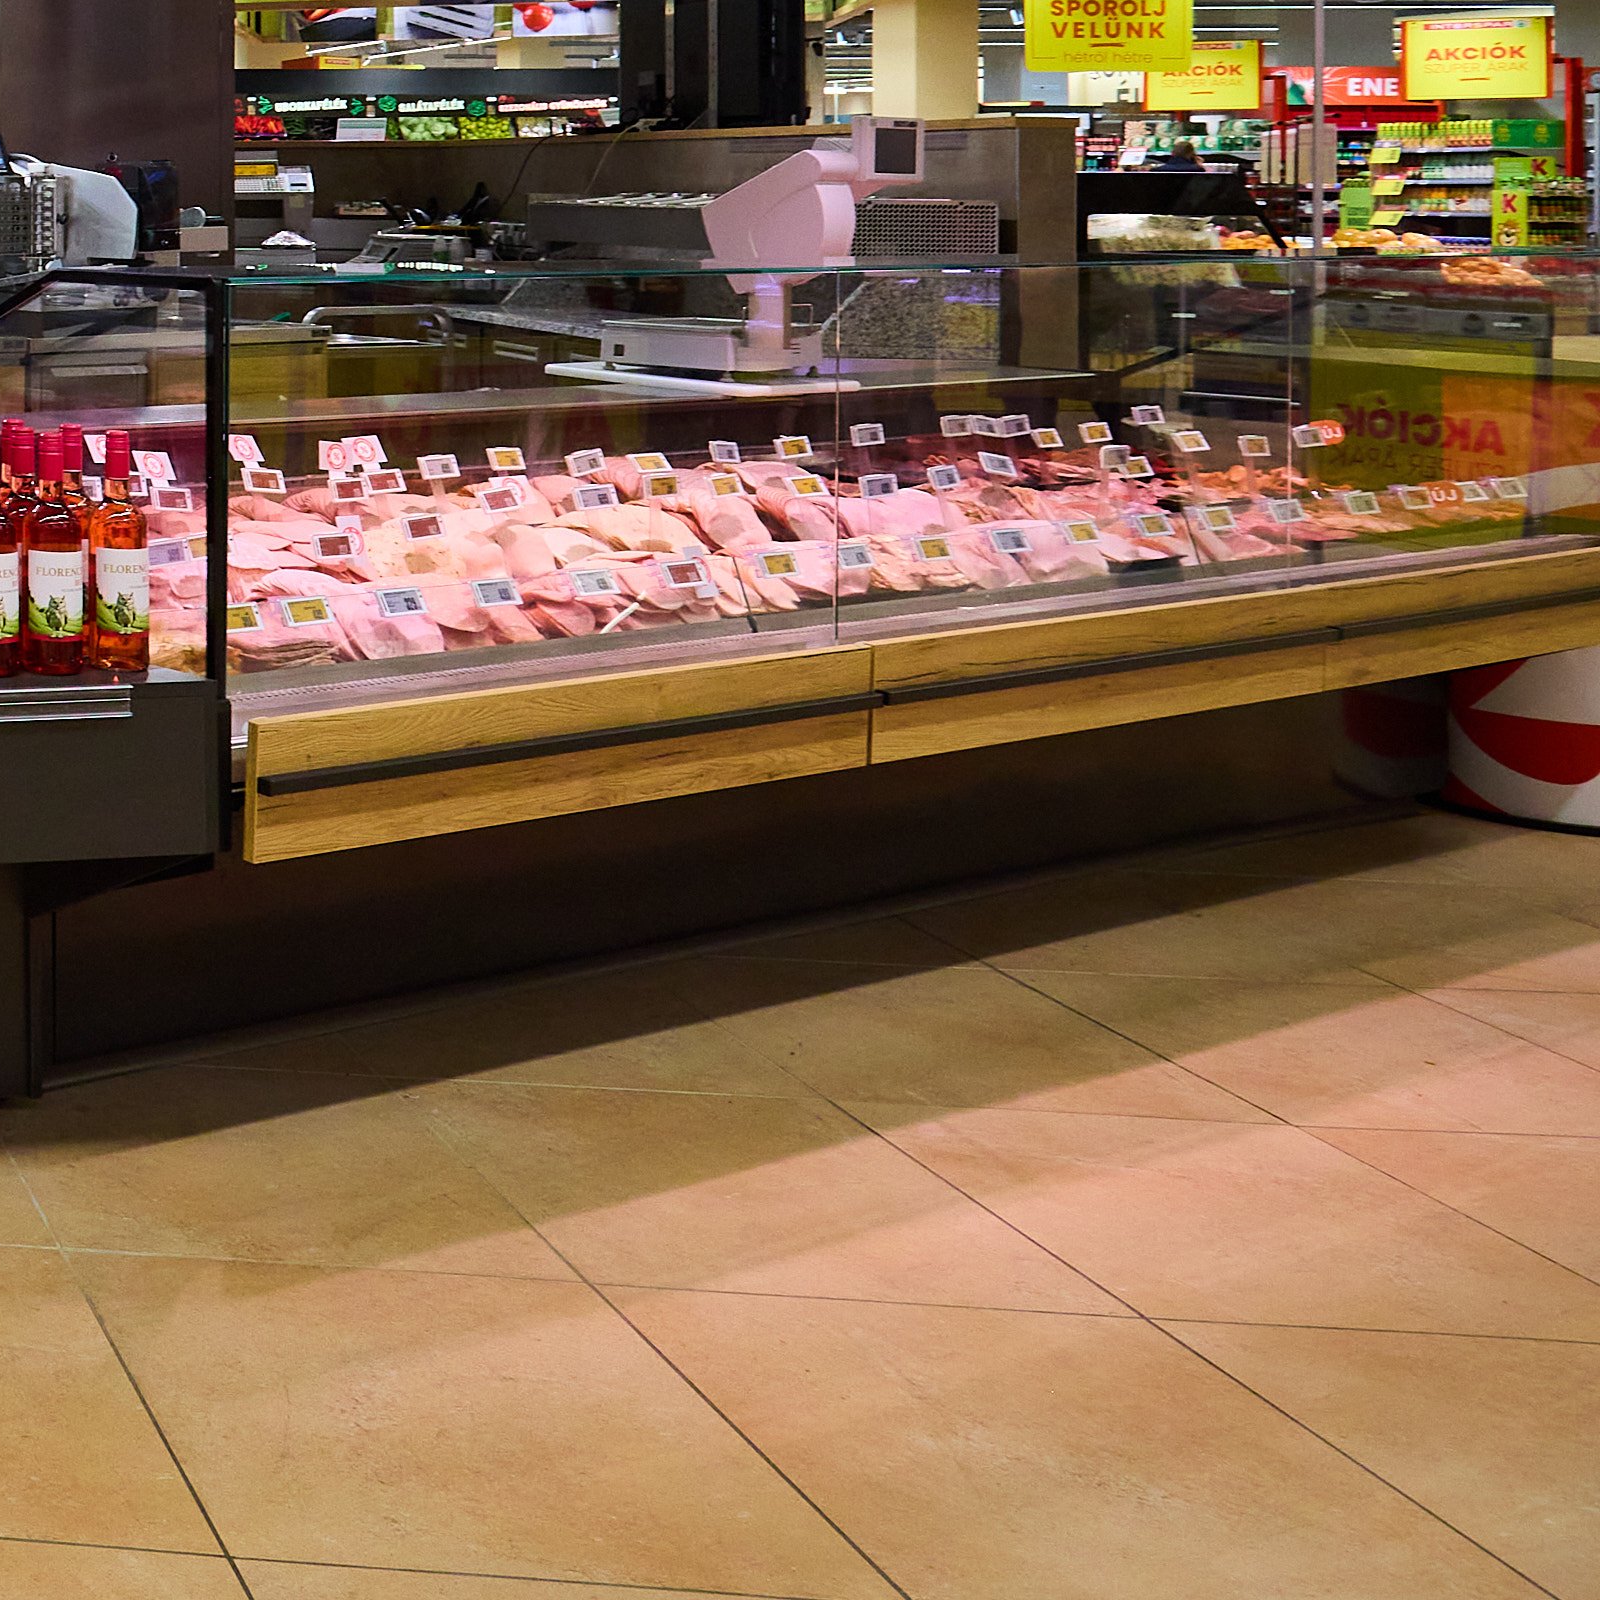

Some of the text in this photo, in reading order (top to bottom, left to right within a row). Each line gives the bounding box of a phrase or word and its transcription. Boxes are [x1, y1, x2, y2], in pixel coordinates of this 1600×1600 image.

[1051, 18, 1165, 39] VELÜNK
[1425, 43, 1527, 62] AKCIÓK
[1502, 194, 1517, 213] K
